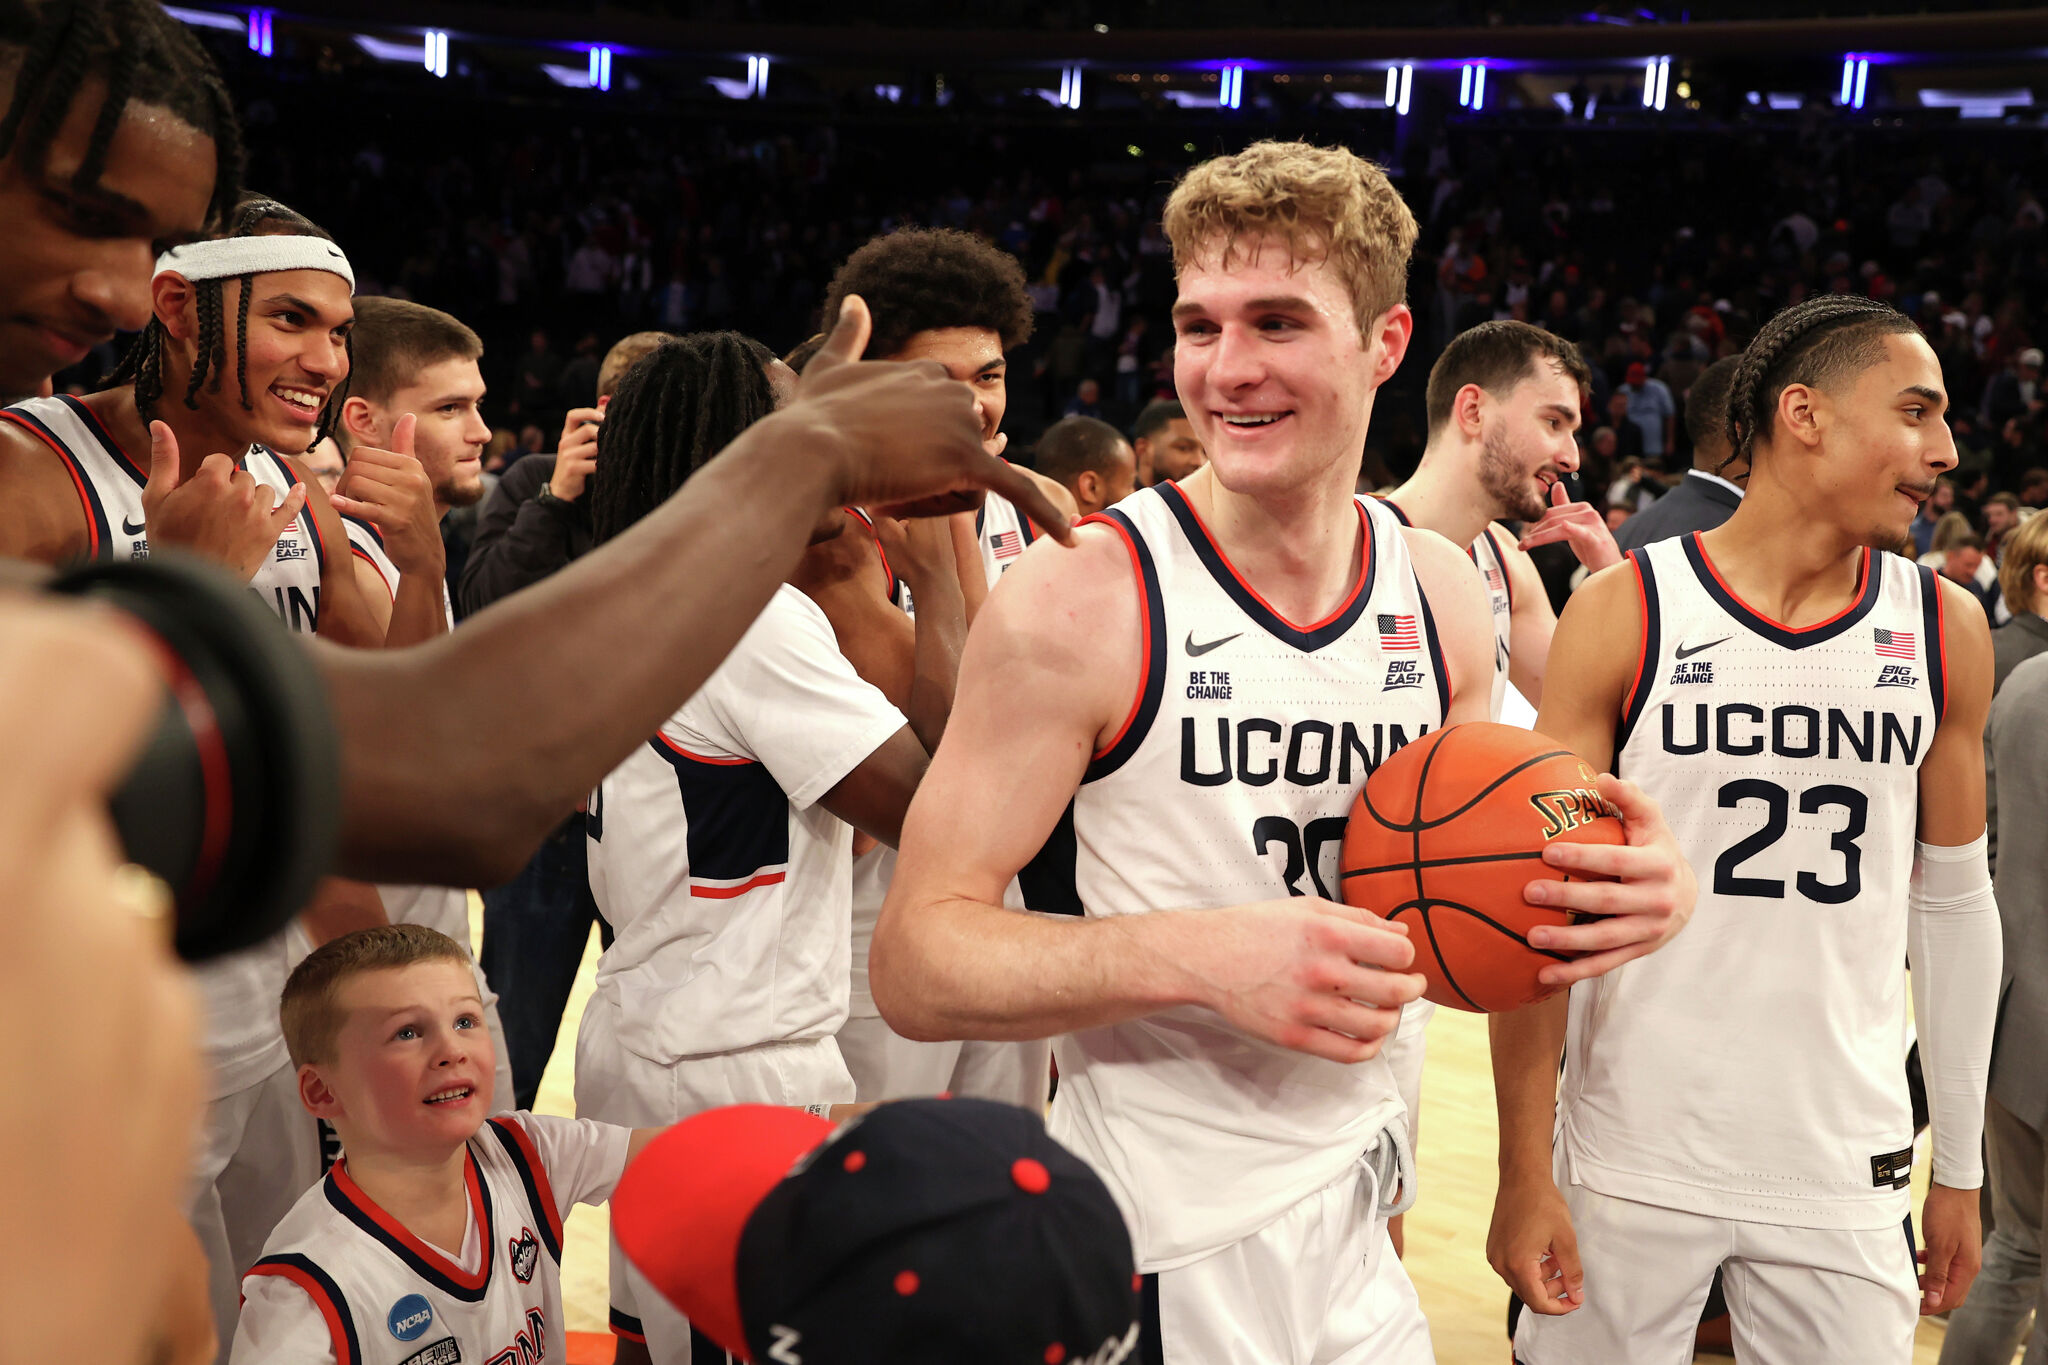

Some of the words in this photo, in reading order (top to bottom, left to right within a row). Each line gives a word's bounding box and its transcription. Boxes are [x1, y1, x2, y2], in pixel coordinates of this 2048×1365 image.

[277, 540, 297, 548] BIG
[277, 549, 308, 557] EAST
[1388, 660, 1417, 673] BIG
[1675, 662, 1690, 674] BE
[1692, 662, 1712, 673] THE
[1882, 665, 1912, 676] BIG
[1190, 671, 1206, 684] BE
[1210, 671, 1230, 685] THE
[1385, 673, 1425, 685] EAST
[1670, 673, 1714, 685] CHANGE
[1877, 675, 1919, 686] EAST
[1186, 685, 1232, 700] CHANGE
[1662, 703, 1922, 765] UCONN
[1529, 788, 1623, 840] SPAL
[1713, 778, 1868, 904] 23
[396, 1309, 431, 1334] NCAA
